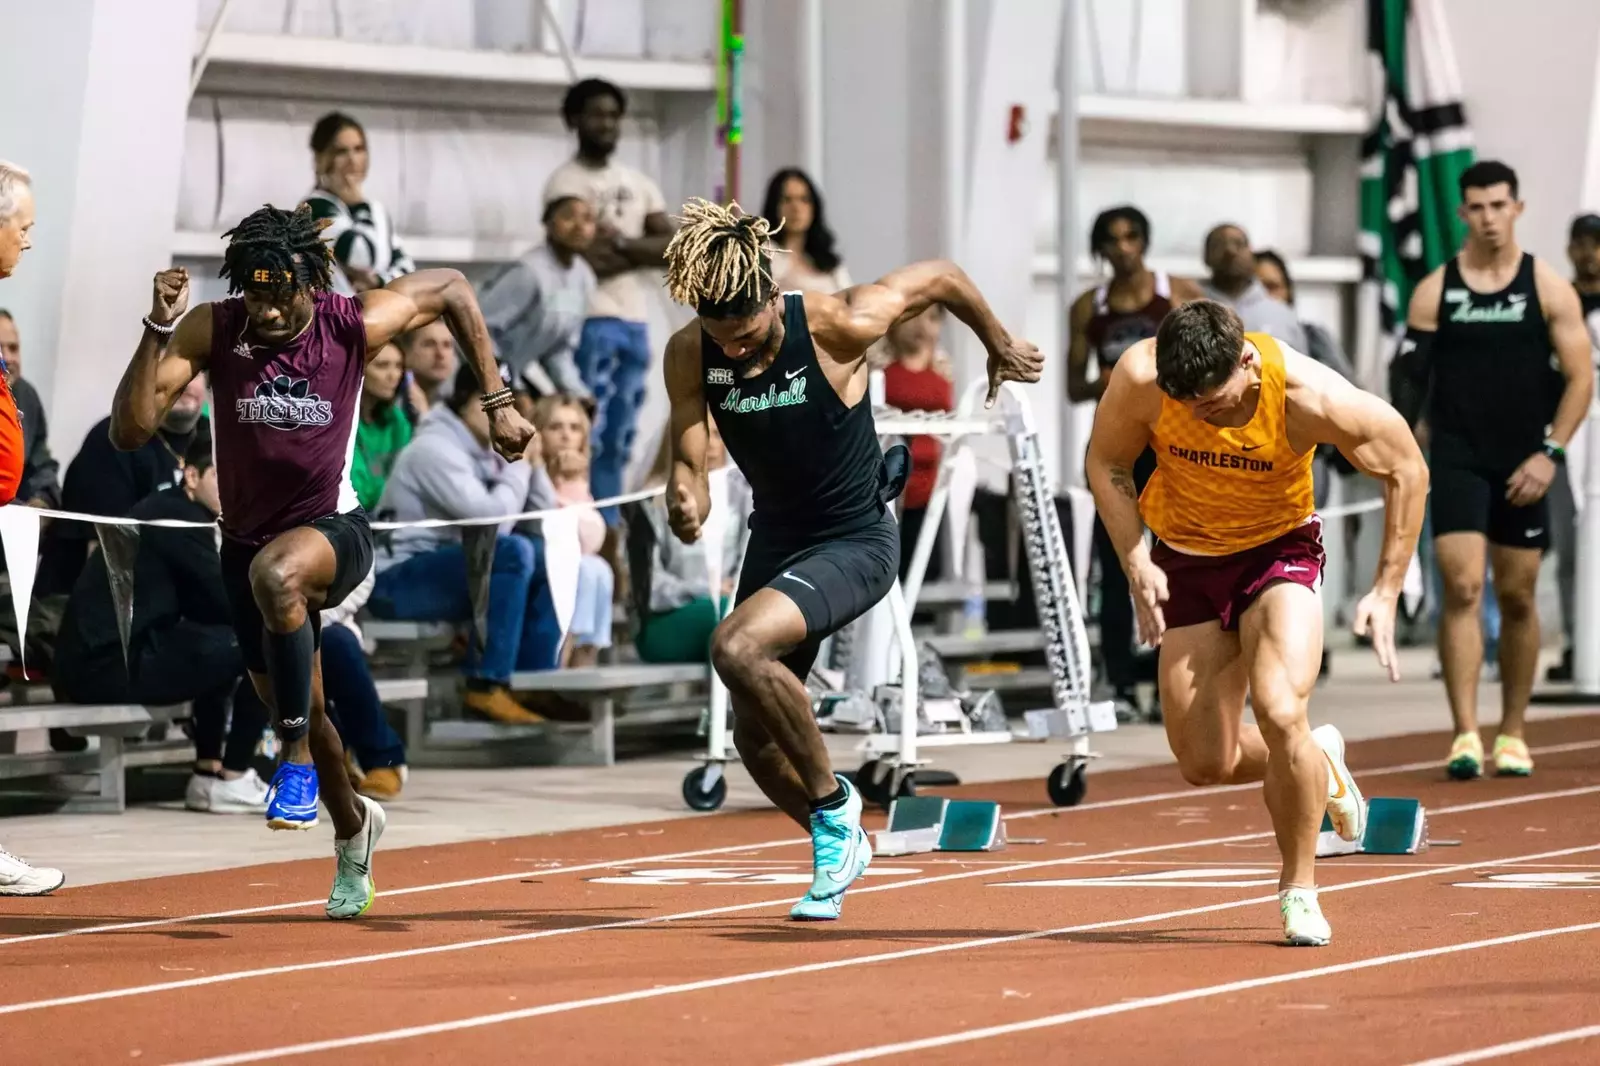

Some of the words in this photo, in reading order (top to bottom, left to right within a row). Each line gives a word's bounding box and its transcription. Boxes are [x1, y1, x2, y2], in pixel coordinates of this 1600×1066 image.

[720, 376, 807, 413] Marshall
[236, 398, 334, 426] TIGERS
[1169, 444, 1274, 472] CHARLESTON
